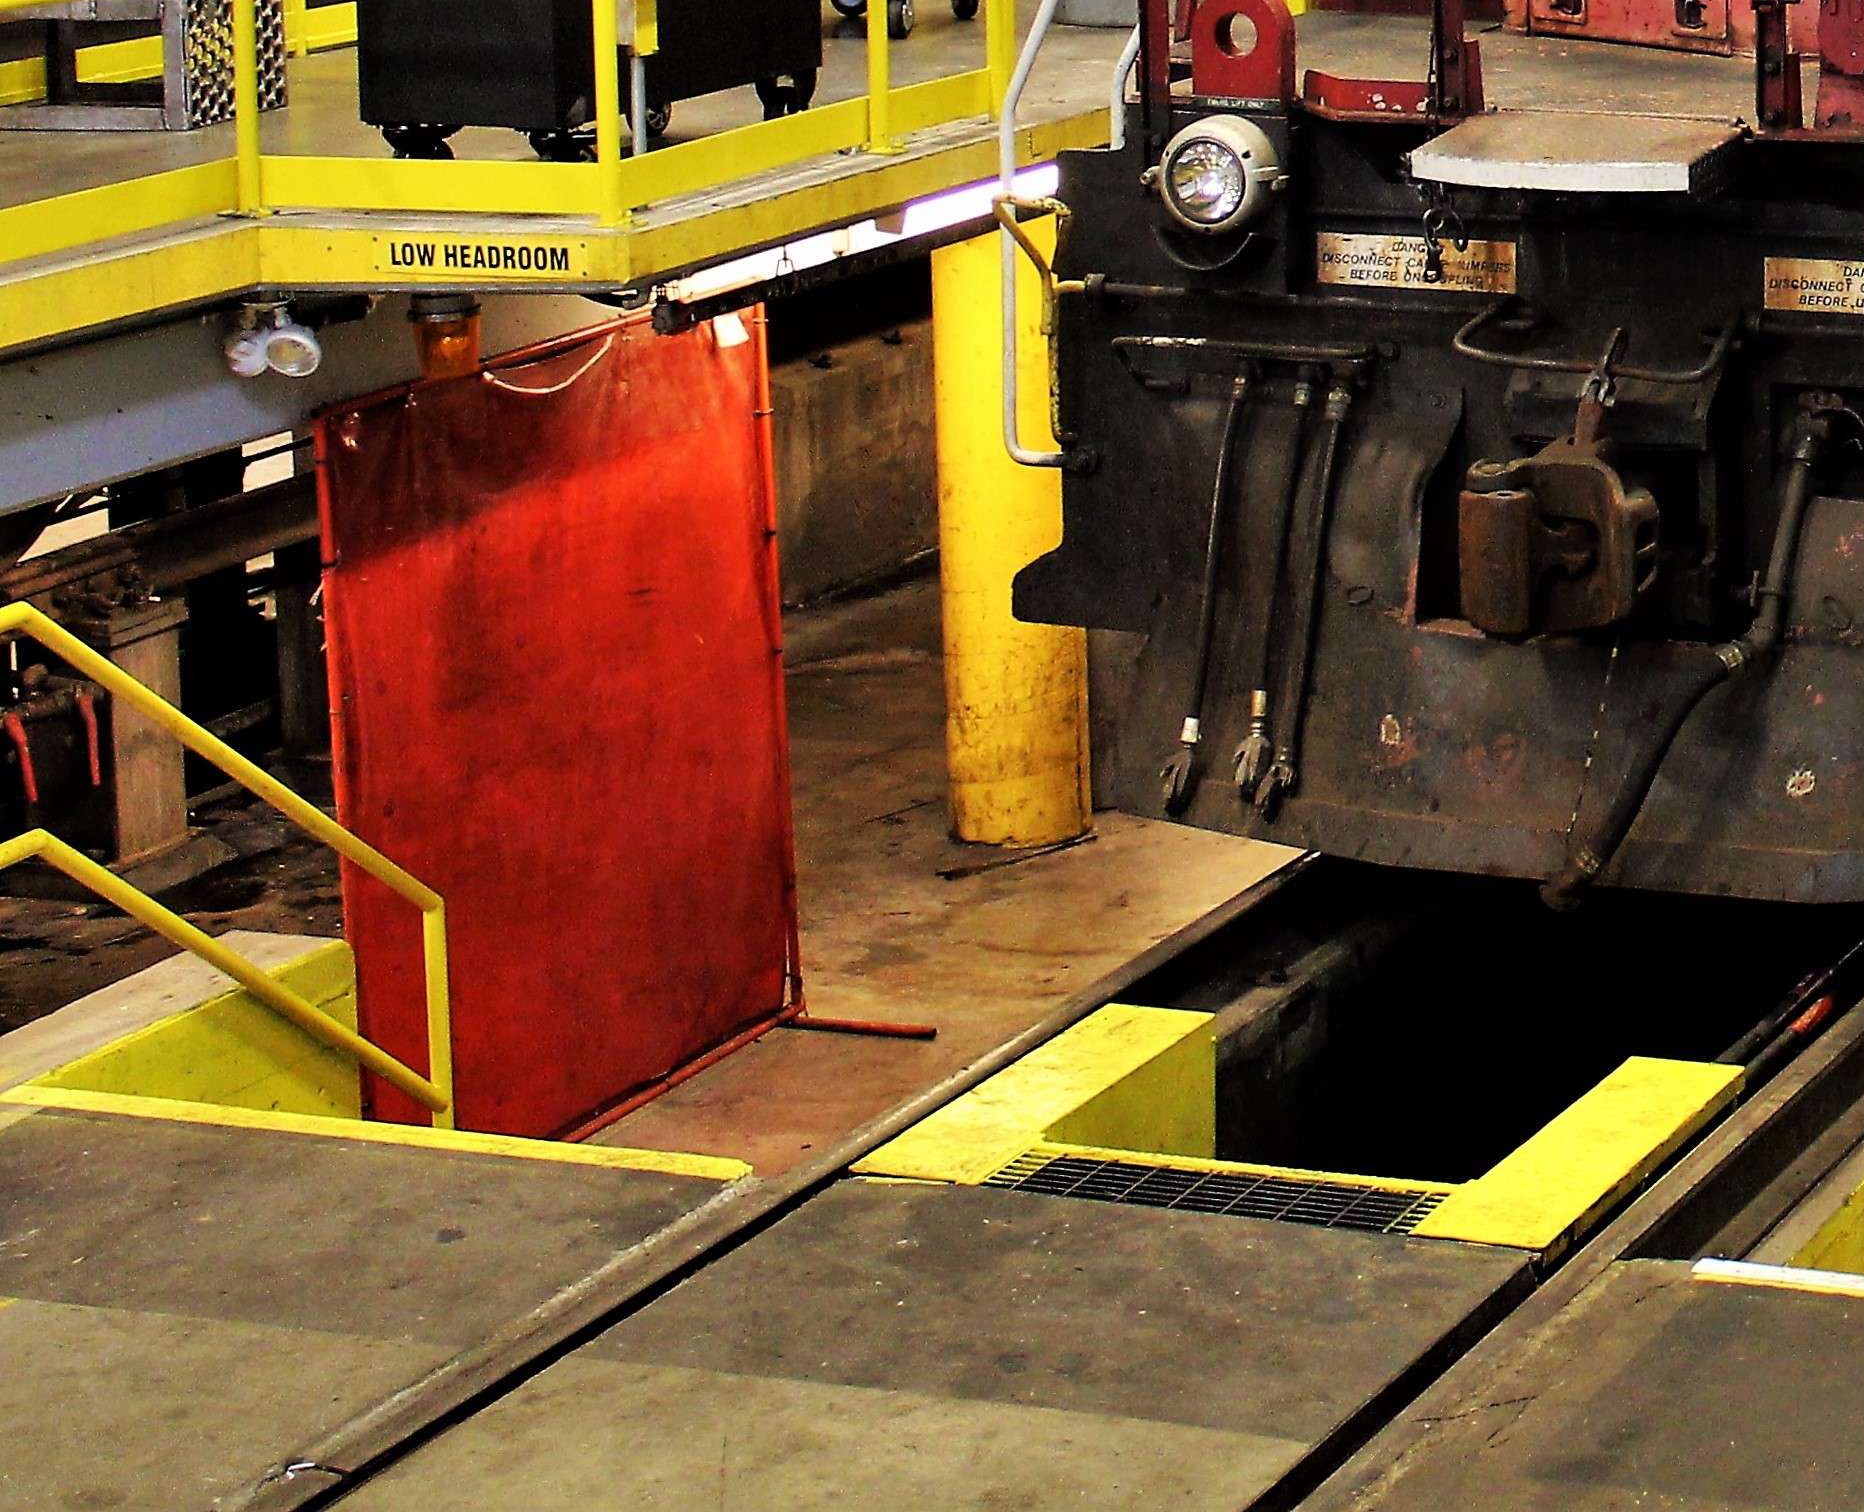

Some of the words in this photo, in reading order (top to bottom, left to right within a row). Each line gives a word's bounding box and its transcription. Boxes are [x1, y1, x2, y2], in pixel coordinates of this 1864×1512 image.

[390, 243, 435, 266] LOW
[444, 244, 569, 271] HEADROOM
[1322, 253, 1400, 267] DISCONNECT
[1350, 269, 1398, 282] BEFORE
[1769, 278, 1852, 292] DISCONNECT
[1798, 295, 1848, 307] BEFORE
